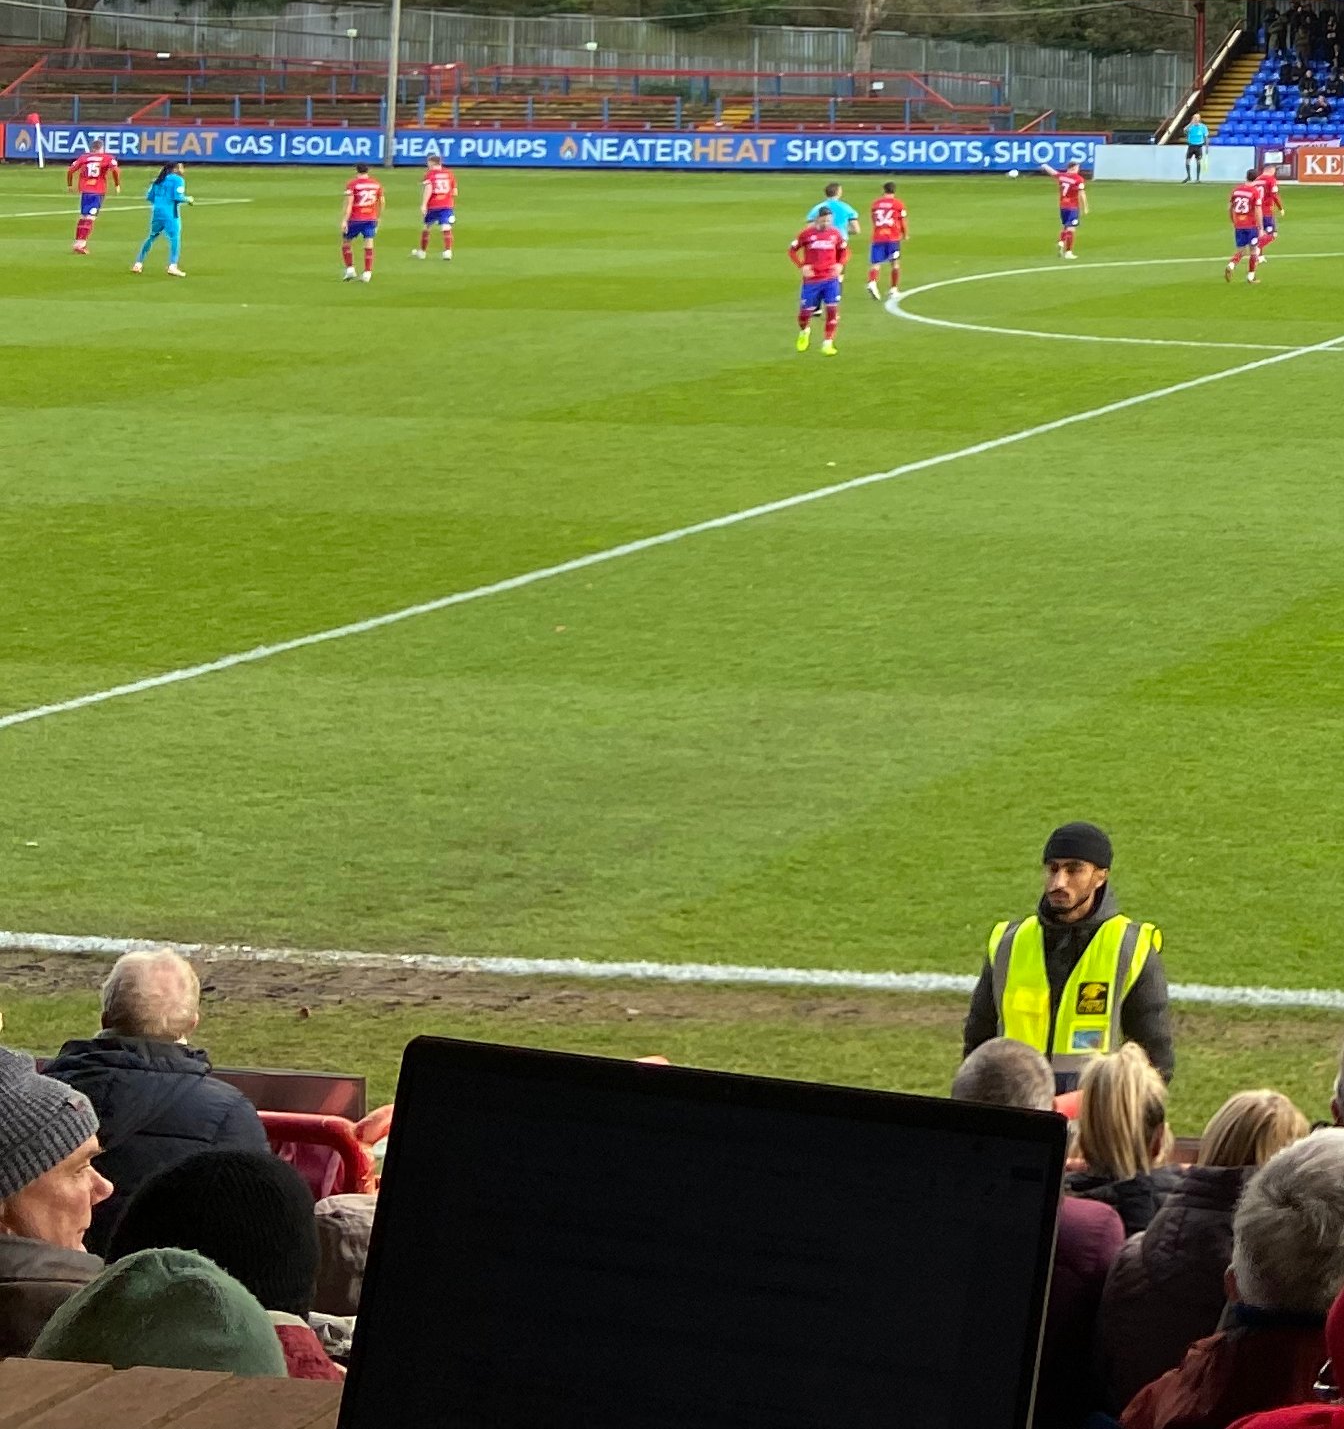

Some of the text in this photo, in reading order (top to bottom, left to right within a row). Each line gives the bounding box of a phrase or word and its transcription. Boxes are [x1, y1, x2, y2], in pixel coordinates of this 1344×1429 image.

[224, 134, 273, 155] GAS
[291, 136, 371, 157] SOLAR
[393, 137, 455, 158] HEAT
[460, 138, 547, 159] PUMPS
[581, 137, 776, 163] NEATERHEAT
[86, 163, 100, 178] 15
[1060, 182, 1071, 197] 7
[358, 190, 377, 207] 25
[1234, 197, 1250, 214] 23
[874, 209, 895, 227] 34
